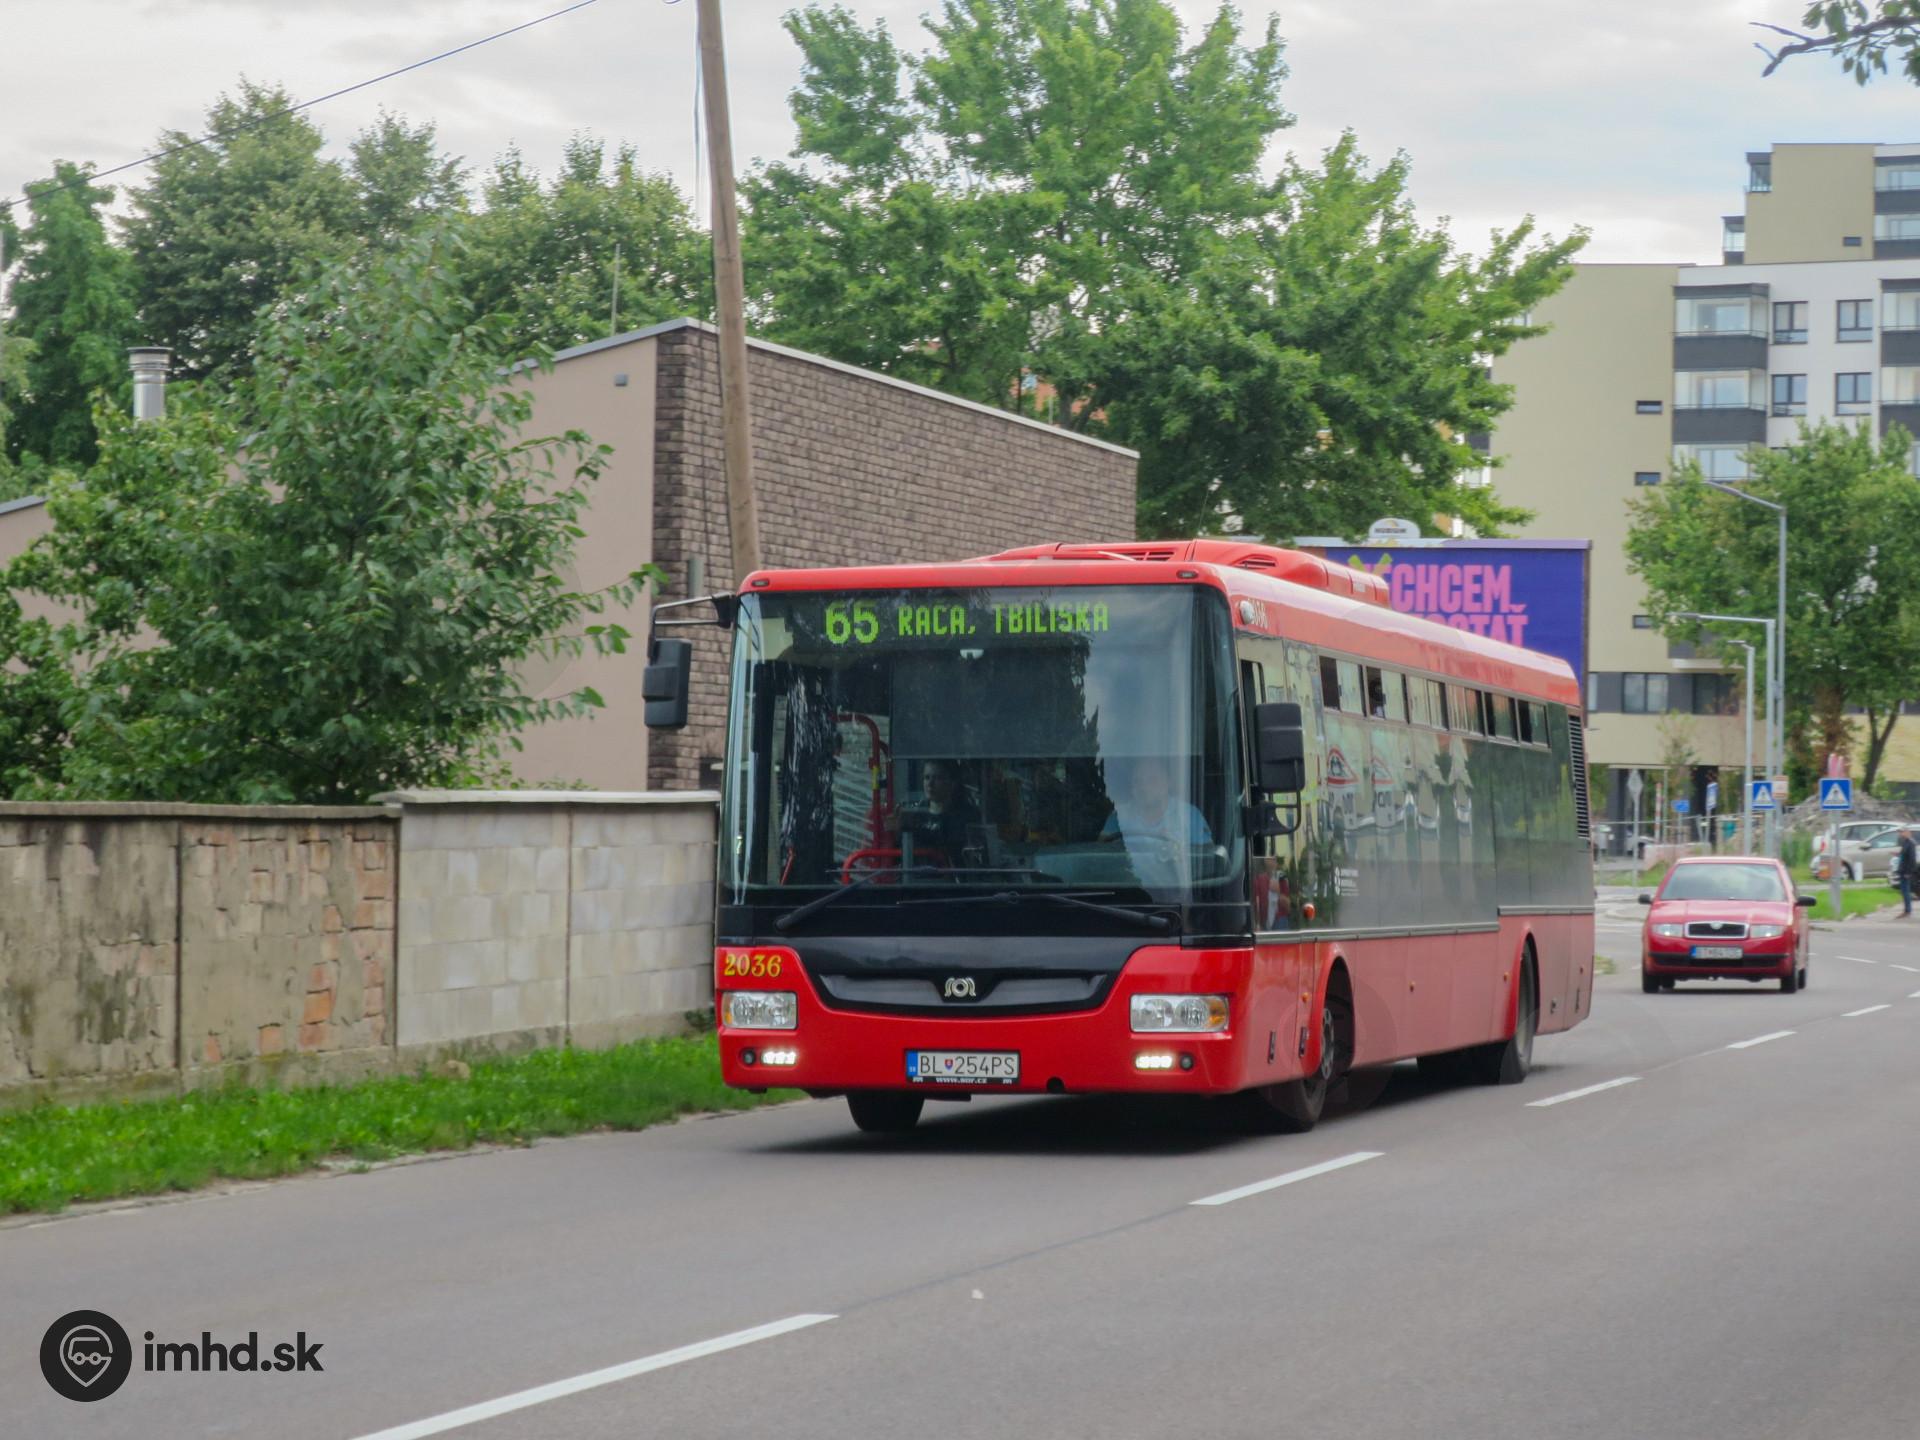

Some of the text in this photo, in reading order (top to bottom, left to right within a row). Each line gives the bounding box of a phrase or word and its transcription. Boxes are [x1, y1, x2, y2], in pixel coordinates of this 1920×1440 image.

[825, 600, 879, 644] 65
[724, 952, 782, 978] 2036
[919, 1055, 1015, 1076] BL 254PS
